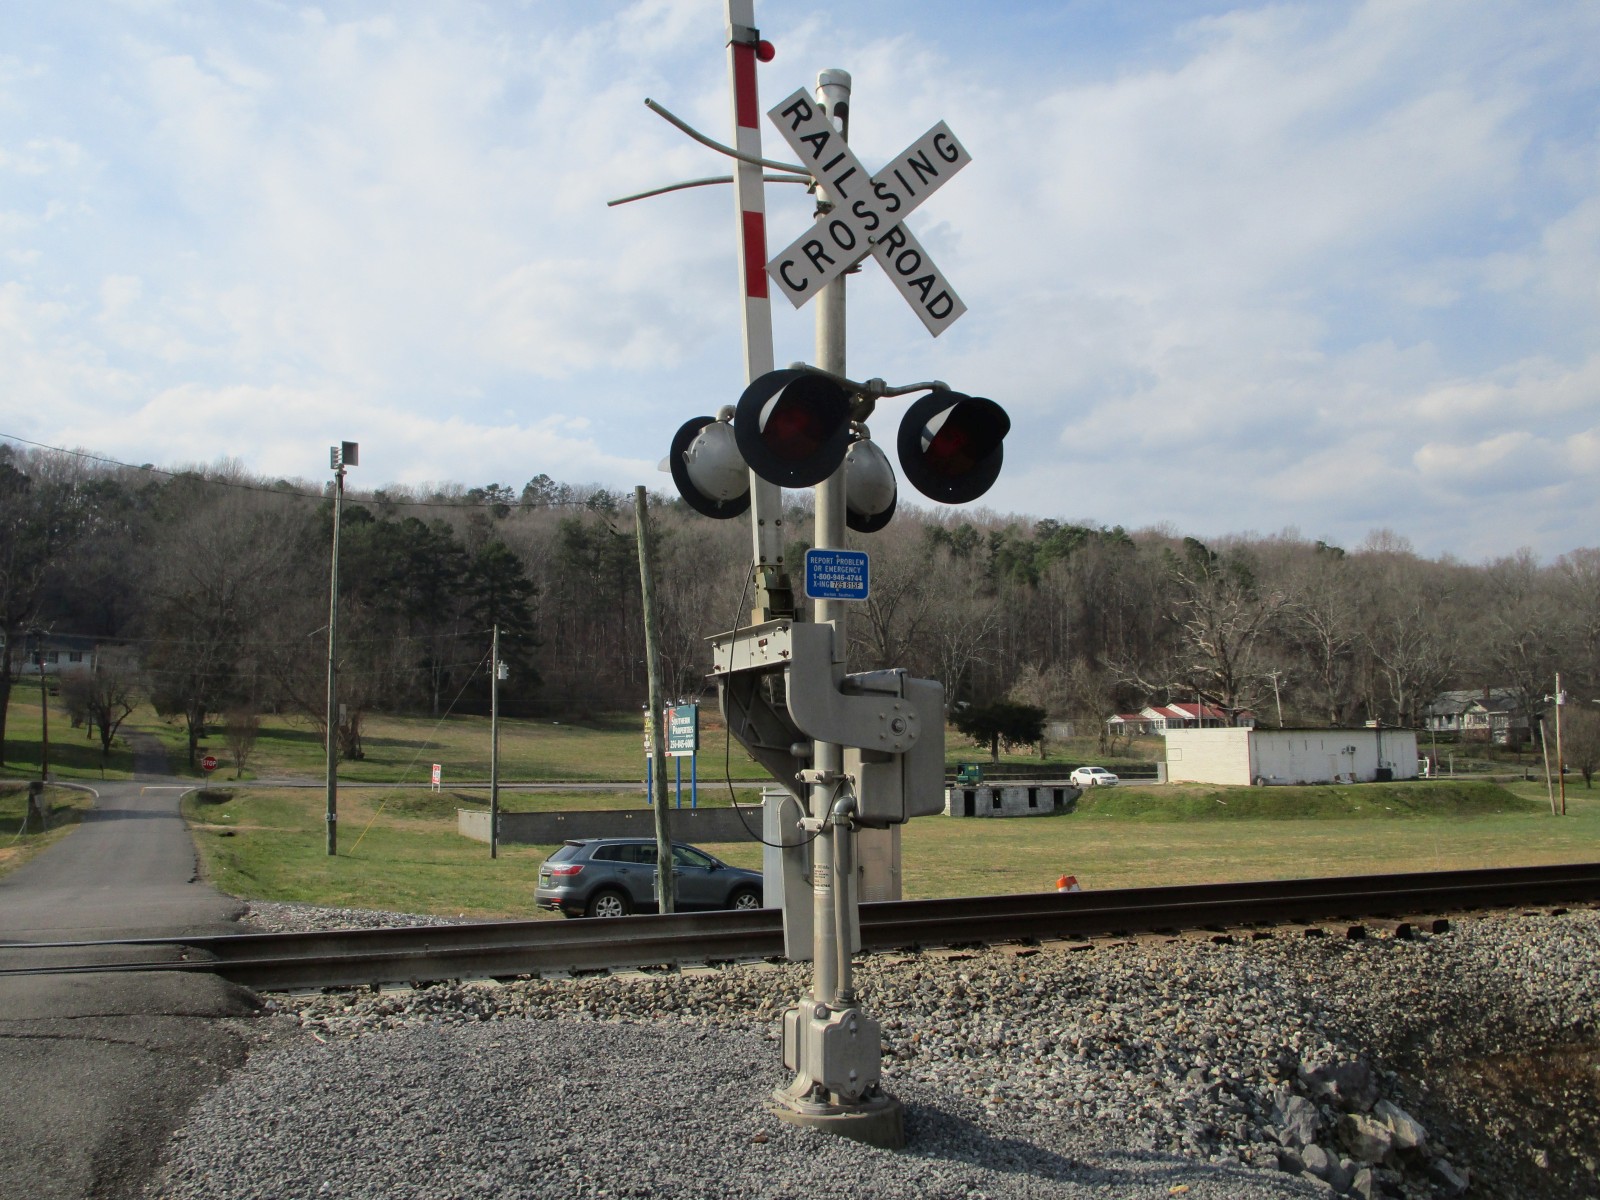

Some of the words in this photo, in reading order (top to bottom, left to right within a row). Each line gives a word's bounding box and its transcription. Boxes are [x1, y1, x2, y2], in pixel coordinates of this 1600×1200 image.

[780, 133, 959, 292] CROSSING
[782, 98, 856, 199] RAIL
[877, 225, 954, 319] ROAD
[813, 573, 862, 581] 1-800-946-4744
[837, 558, 864, 566] PROBLEM
